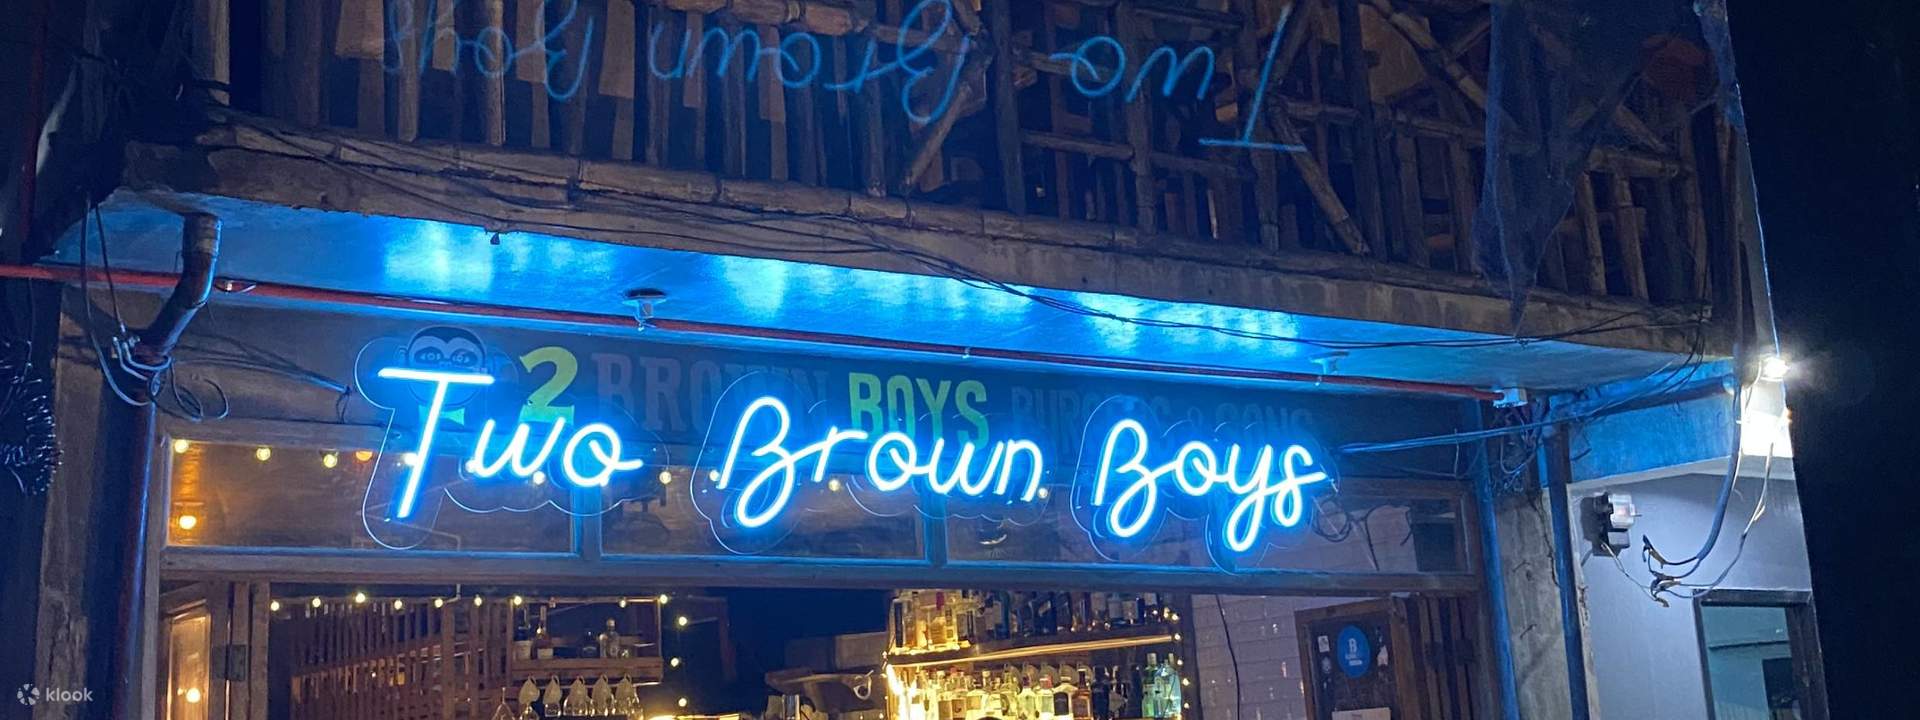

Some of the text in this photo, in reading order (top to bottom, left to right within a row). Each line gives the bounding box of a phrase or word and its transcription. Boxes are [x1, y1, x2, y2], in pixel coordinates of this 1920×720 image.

[648, 0, 972, 125] Brown
[1049, 4, 1309, 152] Two
[377, 367, 1328, 552] Two Brown Boys
[519, 345, 579, 424] 2
[847, 371, 990, 448] BOYS
